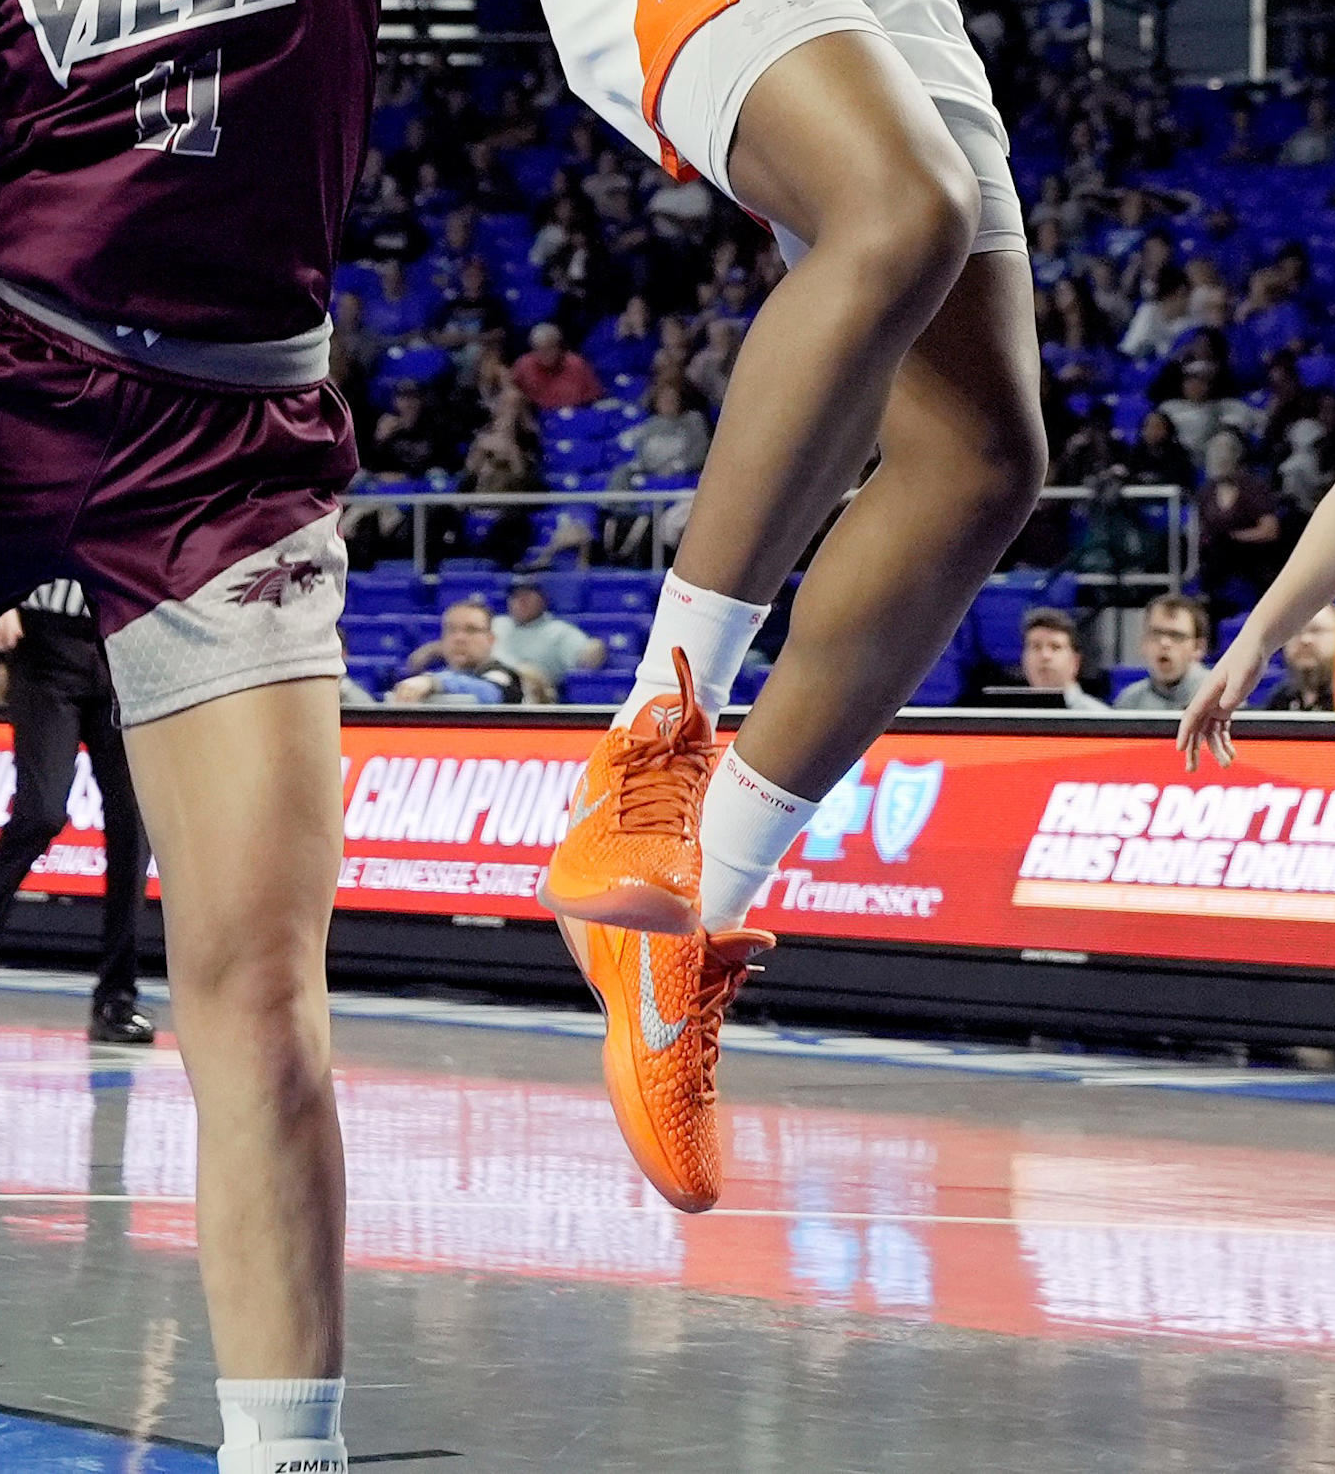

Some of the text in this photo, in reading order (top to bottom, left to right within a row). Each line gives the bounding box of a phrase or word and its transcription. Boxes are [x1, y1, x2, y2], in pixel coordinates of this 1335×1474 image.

[135, 48, 221, 157] 11
[726, 758, 797, 815] Supreme
[1037, 781, 1159, 839] FANS
[1147, 782, 1303, 843] DON'T
[359, 856, 478, 894] TENNESSEE
[470, 861, 542, 898] STATE
[1019, 833, 1123, 883] FANS
[1111, 836, 1236, 887] DRIVE
[780, 868, 945, 917] Tennessee
